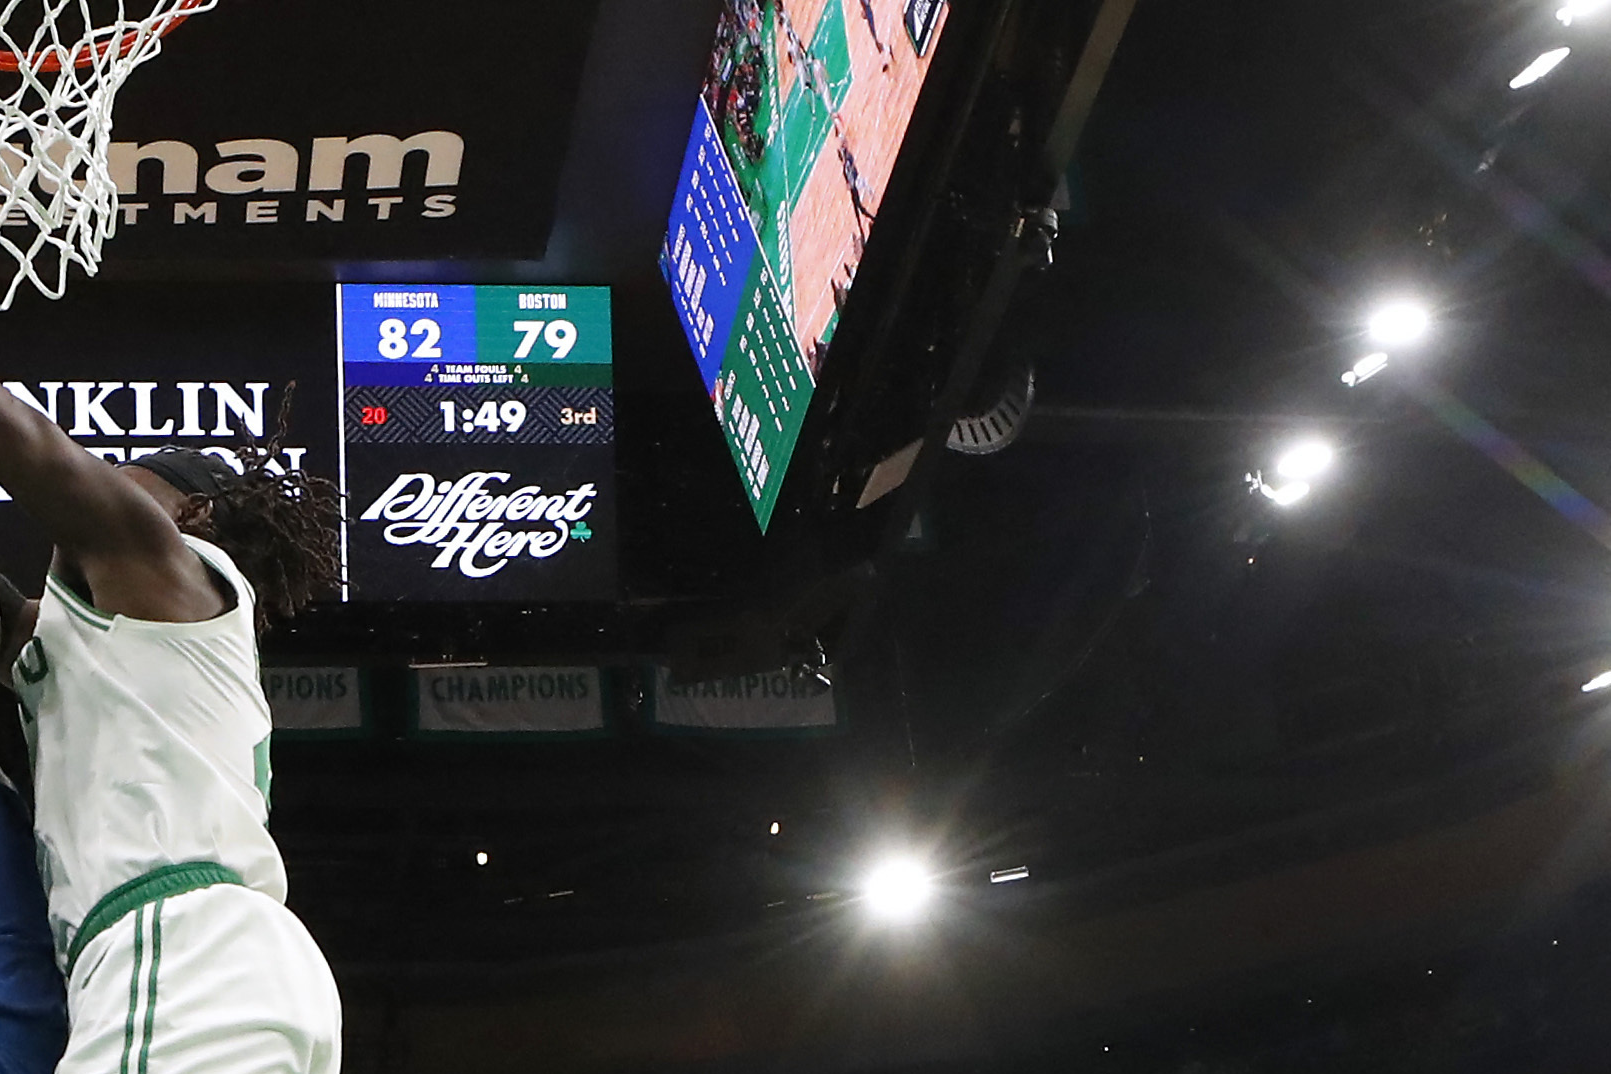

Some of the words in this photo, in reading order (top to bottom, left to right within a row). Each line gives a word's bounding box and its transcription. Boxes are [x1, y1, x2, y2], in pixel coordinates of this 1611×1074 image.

[374, 292, 439, 308] MINNESOTA
[519, 293, 567, 309] BOSTON
[378, 318, 442, 359] 82
[513, 319, 578, 359] 79
[438, 374, 462, 383] TIME
[492, 375, 514, 383] LEFT
[445, 365, 473, 373] TEAM
[474, 365, 507, 373] FOULS
[361, 406, 387, 425] 20
[440, 400, 527, 432] 1:49
[560, 407, 597, 425] 3rd
[360, 472, 597, 545] Different
[431, 519, 569, 578] Here
